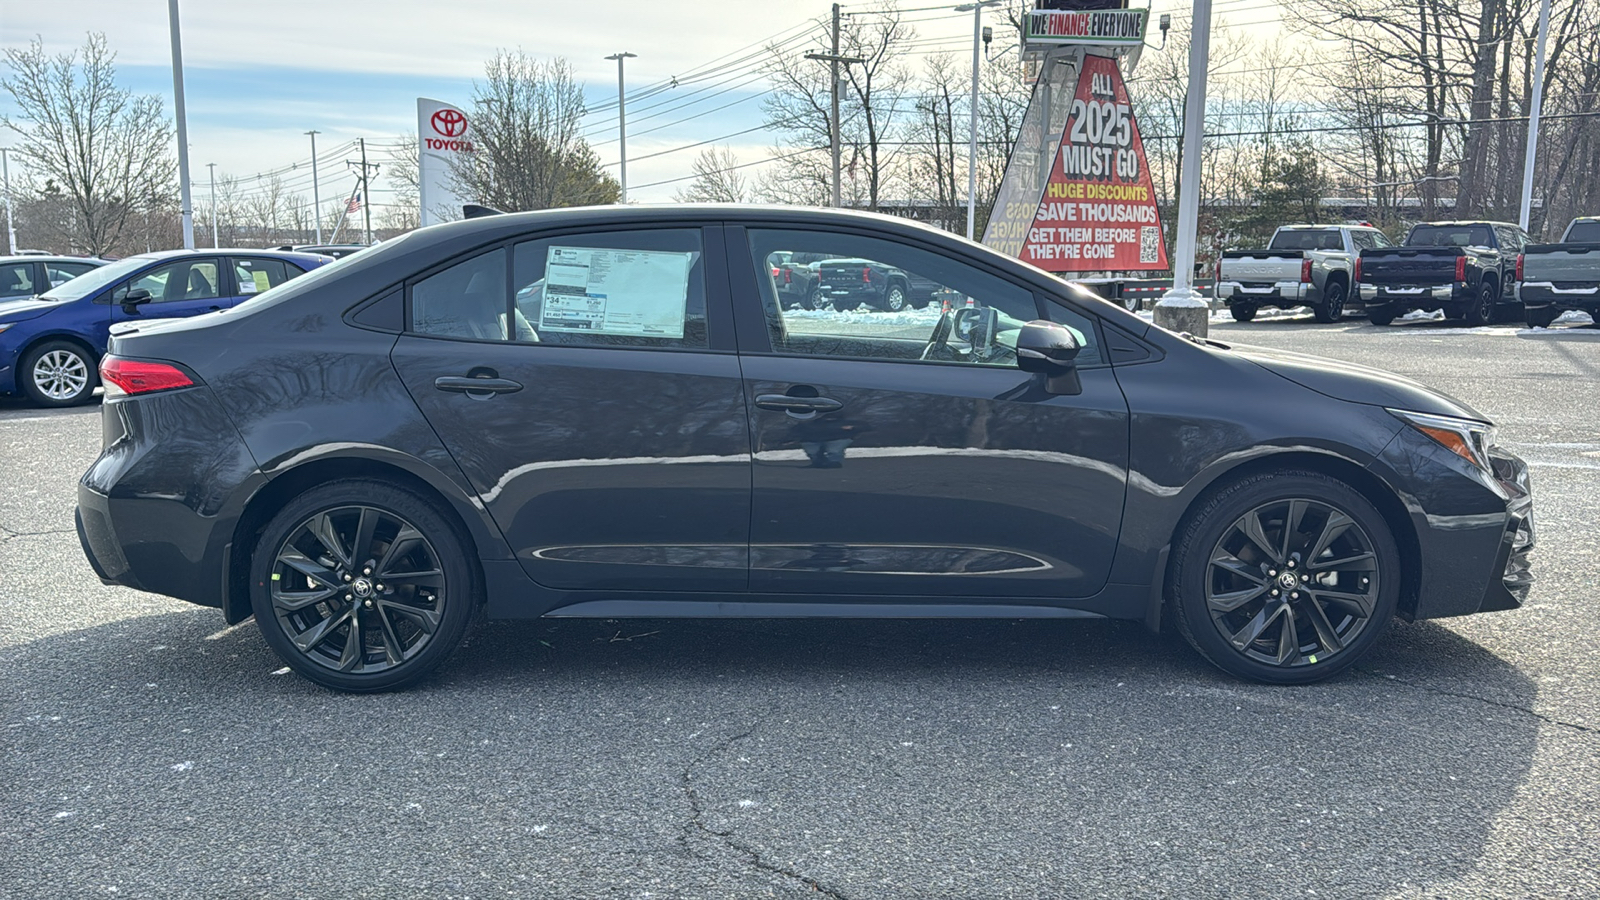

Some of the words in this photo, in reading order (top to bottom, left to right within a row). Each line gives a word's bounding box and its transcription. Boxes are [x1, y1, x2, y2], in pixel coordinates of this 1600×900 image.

[1031, 13, 1047, 35] WE
[1048, 13, 1090, 36] FINANCE
[1091, 12, 1142, 37] EVERYONE
[1091, 72, 1114, 96] ALL
[1070, 99, 1131, 146] 2025
[425, 138, 474, 152] TOYOTA
[1062, 145, 1112, 176] MUST
[1116, 148, 1138, 178] GO
[1048, 183, 1084, 199] HUGE
[1086, 184, 1148, 202] DISCOUNTS
[1036, 203, 1077, 221] SAVE
[1079, 203, 1156, 223] THOUSANDS
[1028, 228, 1056, 243] GET
[1058, 228, 1092, 243] THEM
[1094, 228, 1136, 243] BEFORE
[1027, 244, 1081, 259] THEY'RE
[1083, 244, 1115, 259] GONE
[1236, 266, 1284, 274] TUNDRA
